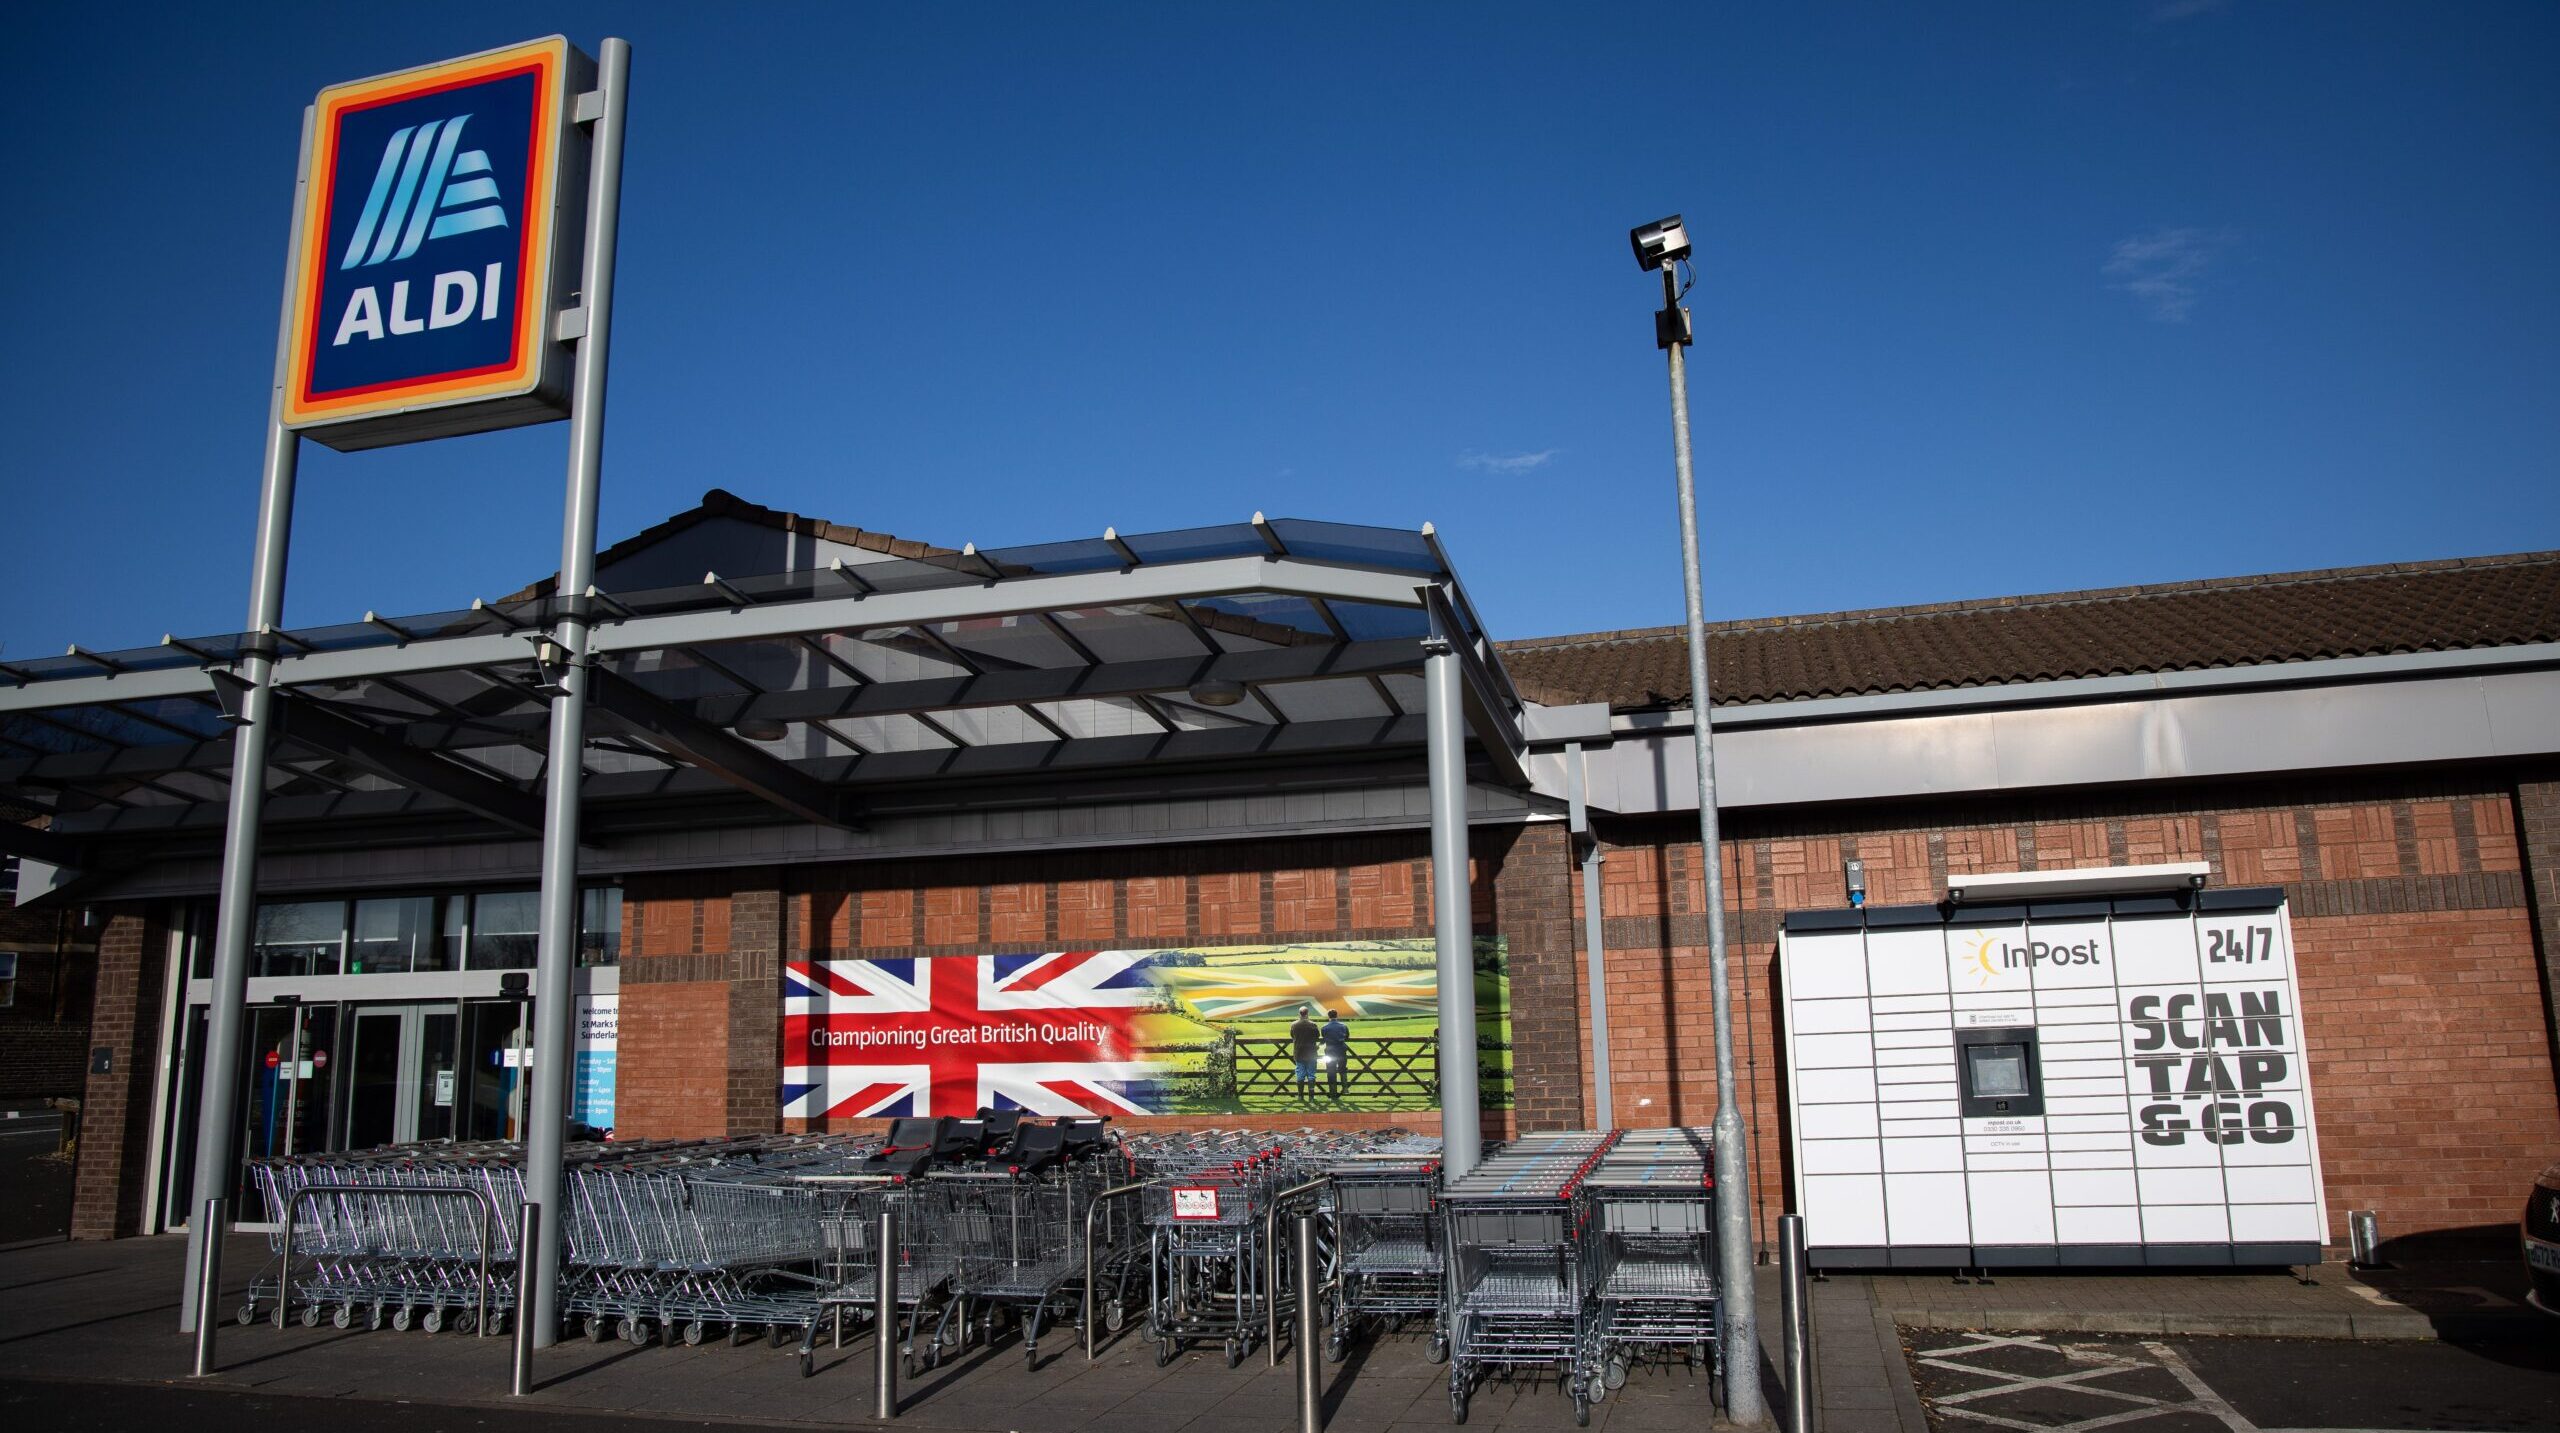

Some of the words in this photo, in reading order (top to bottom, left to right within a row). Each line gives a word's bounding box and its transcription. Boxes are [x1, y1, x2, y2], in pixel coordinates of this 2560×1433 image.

[332, 262, 502, 346] ALDI
[2002, 939, 2100, 969] InPost
[2207, 925, 2273, 964] 24/7
[581, 1020, 589, 1028] St
[590, 1019, 613, 1028] Marks
[582, 1007, 612, 1015] Welcome
[2130, 990, 2284, 1051] SCAN
[811, 1026, 926, 1050] Championing
[930, 1026, 977, 1044] Great
[981, 1023, 1037, 1043] British
[1041, 1021, 1107, 1045] Quality
[2134, 1049, 2288, 1102] TAP
[2140, 1104, 2191, 1147] &
[2201, 1101, 2295, 1145] GO
